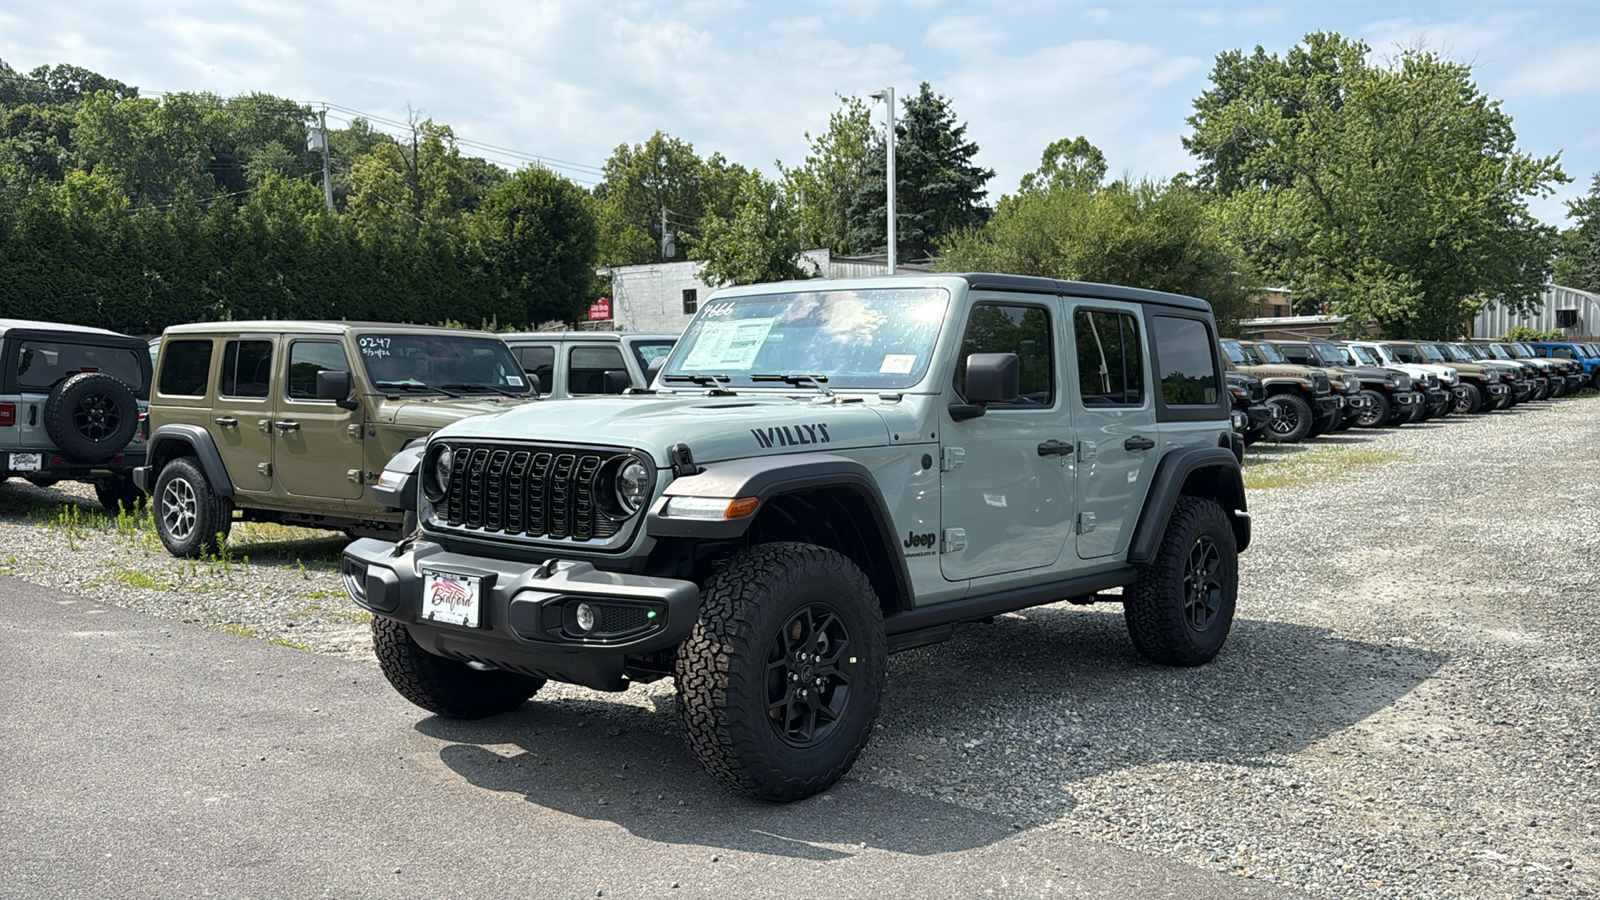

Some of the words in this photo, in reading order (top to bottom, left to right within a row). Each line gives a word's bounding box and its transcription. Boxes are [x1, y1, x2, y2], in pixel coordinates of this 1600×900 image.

[701, 302, 735, 319] 4666
[359, 337, 391, 349] 0247
[750, 423, 831, 448] WILLYS
[904, 531, 936, 549] Jeep
[431, 583, 473, 612] Bedford
